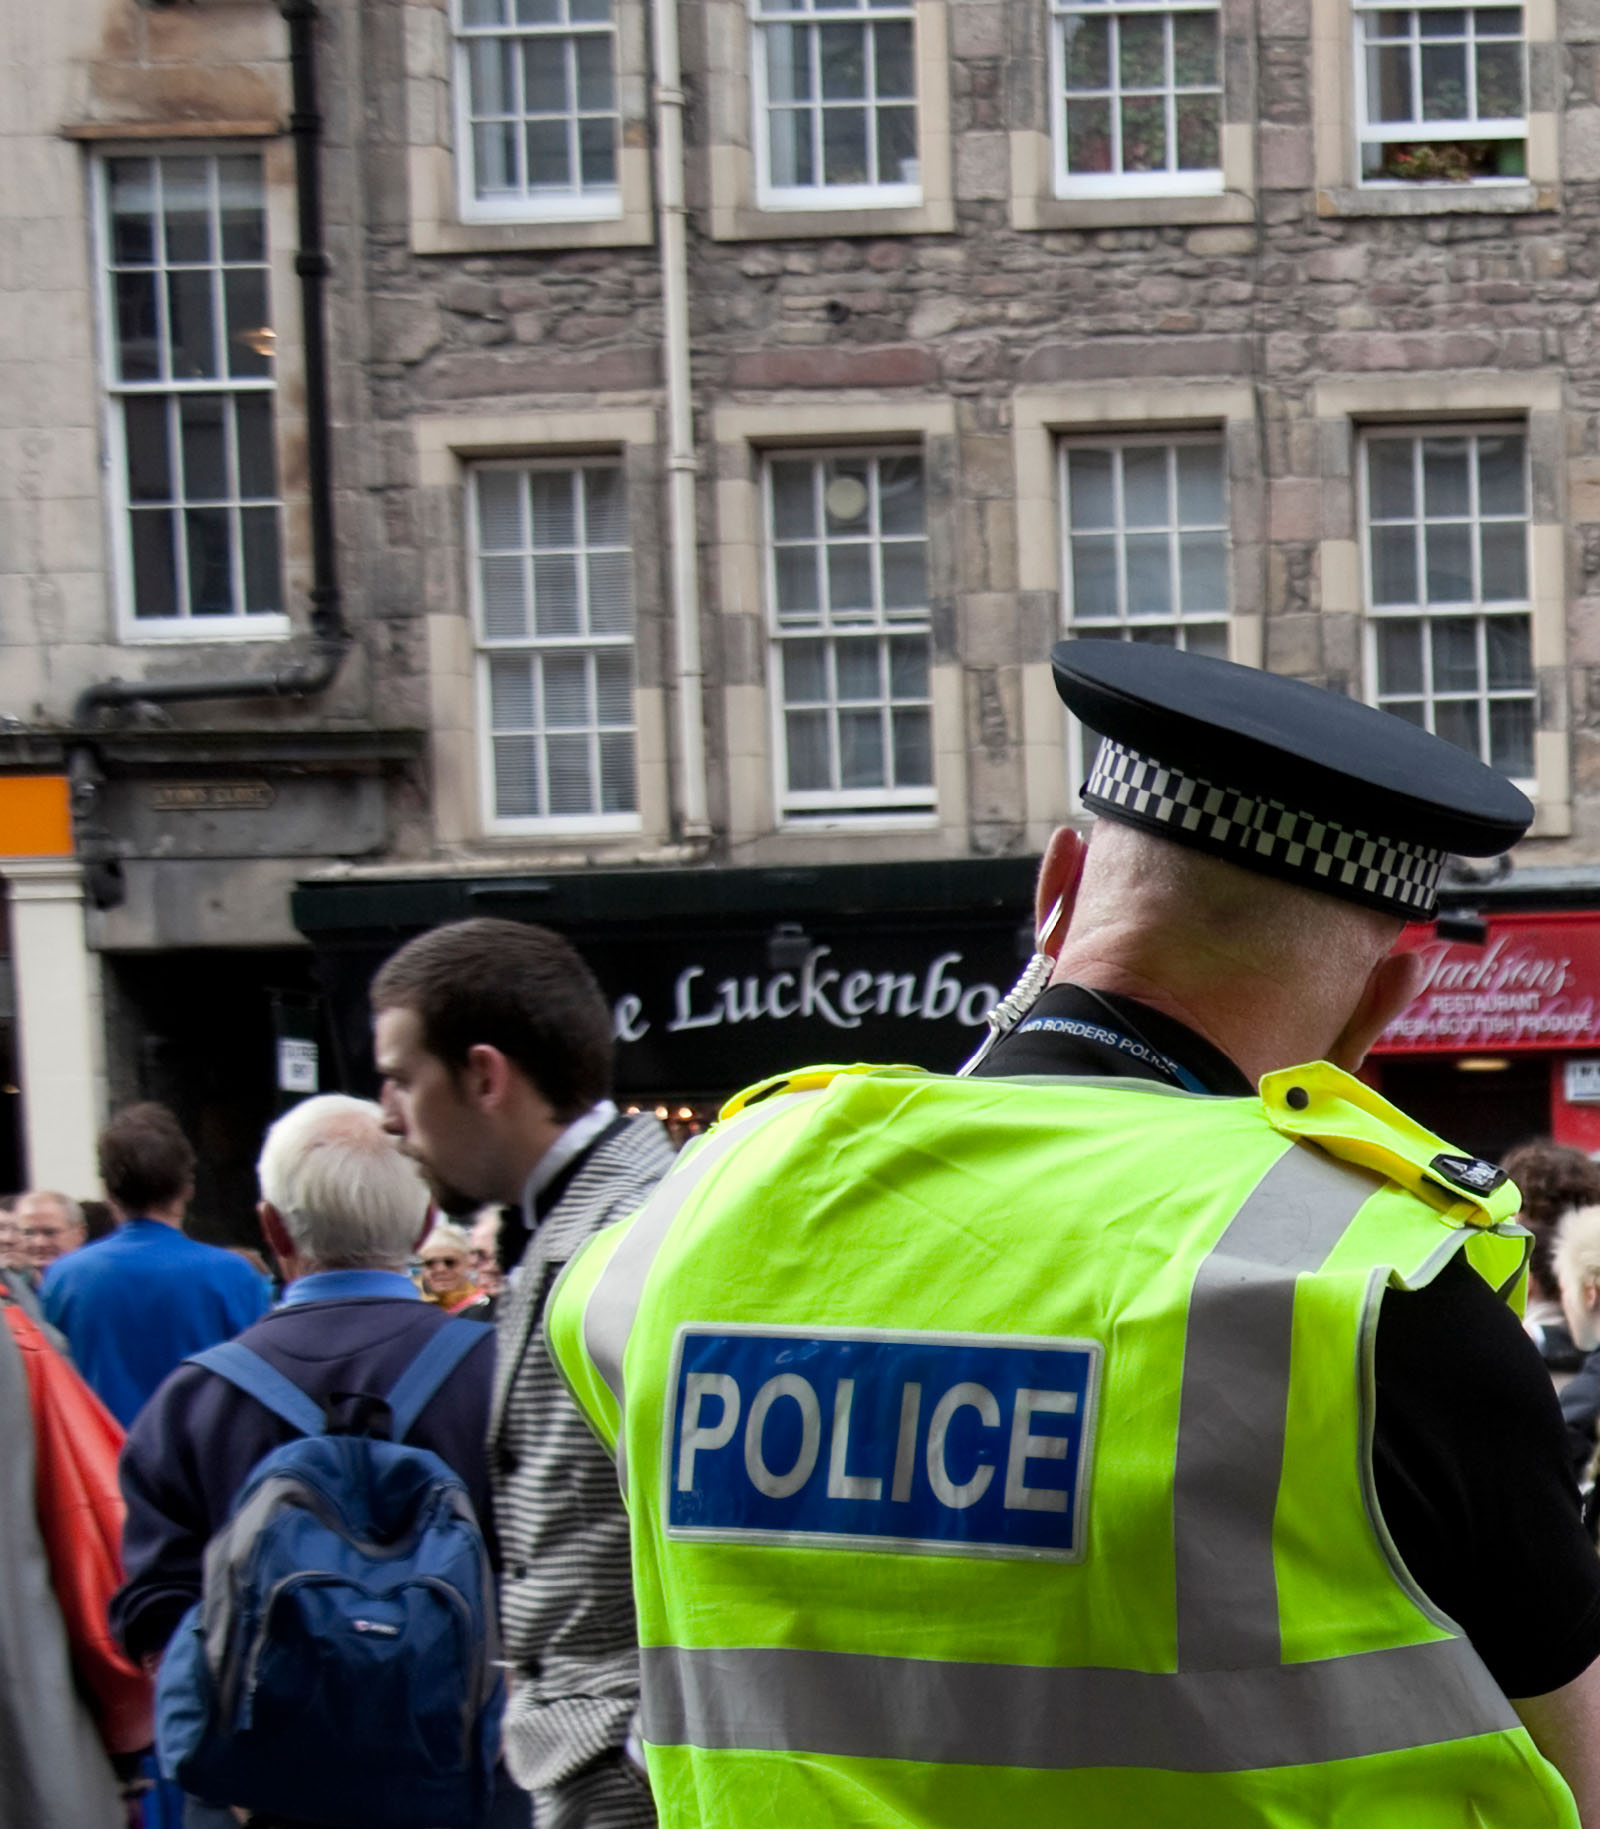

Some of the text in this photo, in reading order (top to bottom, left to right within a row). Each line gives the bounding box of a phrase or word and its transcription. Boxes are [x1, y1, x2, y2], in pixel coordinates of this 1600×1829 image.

[1430, 992, 1541, 1013] RESTAURANT
[1043, 1019, 1119, 1046] BORDERS
[1438, 1015, 1516, 1035] SCOTTISH
[1518, 1013, 1592, 1033] PRODUCE
[677, 1373, 1079, 1513] POLICE
